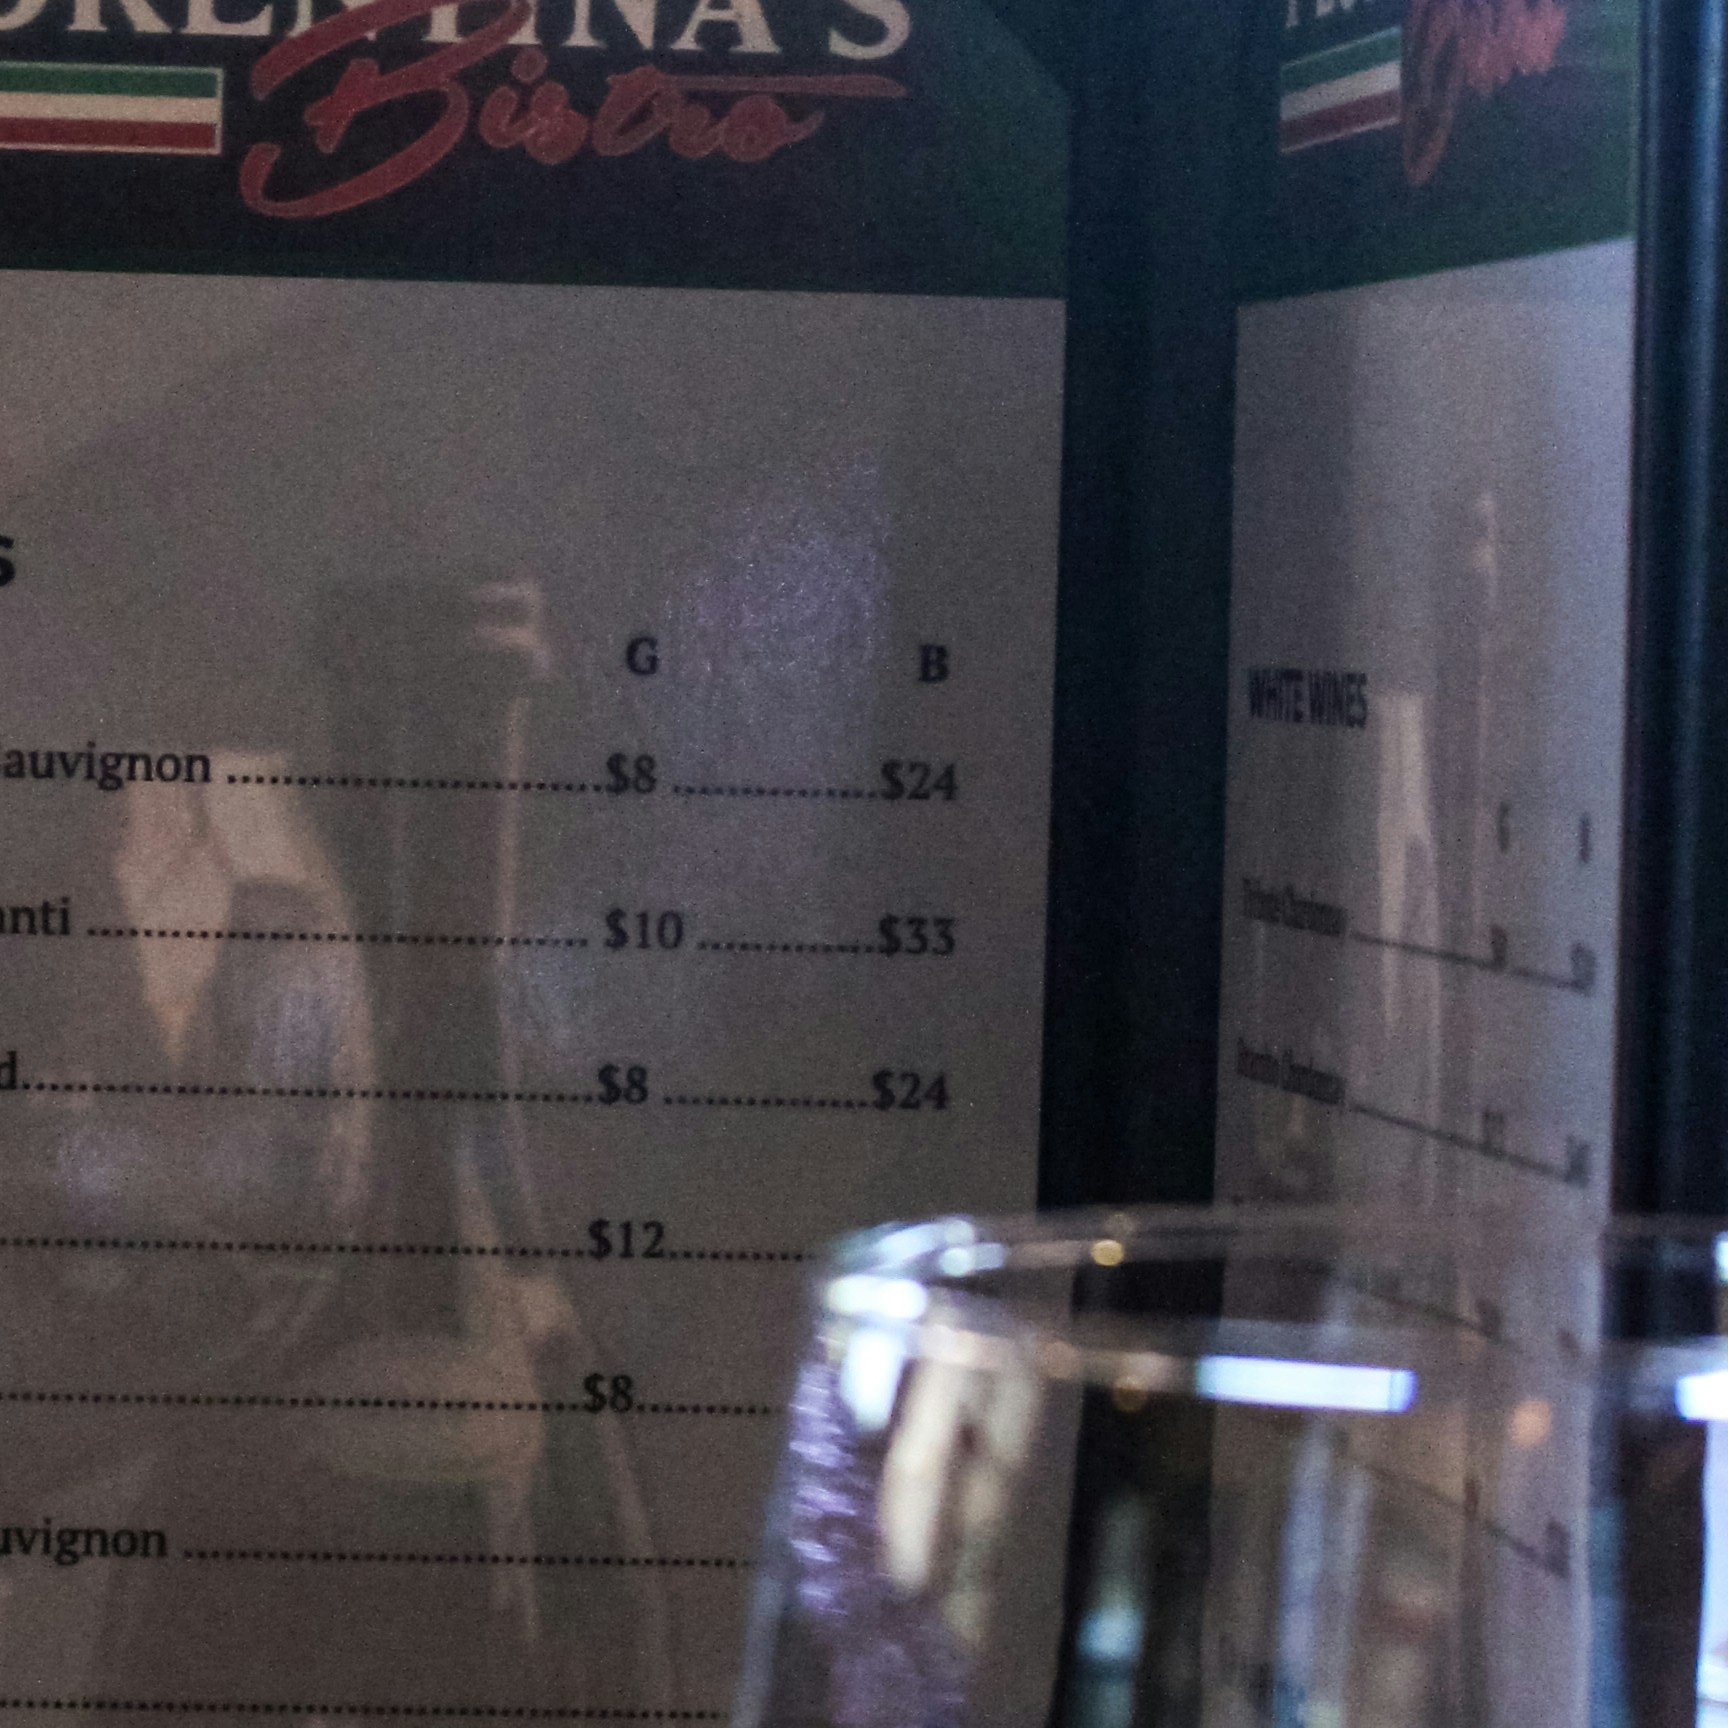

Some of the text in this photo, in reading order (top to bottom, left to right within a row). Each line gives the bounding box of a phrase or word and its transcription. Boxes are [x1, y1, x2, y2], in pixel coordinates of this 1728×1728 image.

[624, 635, 950, 684] G B
[605, 752, 657, 796] $8
[881, 759, 958, 802] $24
[605, 907, 956, 958] $10 $33
[597, 1063, 649, 1106] $8
[871, 1069, 950, 1111] $24
[587, 1218, 666, 1261] $12
[582, 1372, 634, 1414] $8
